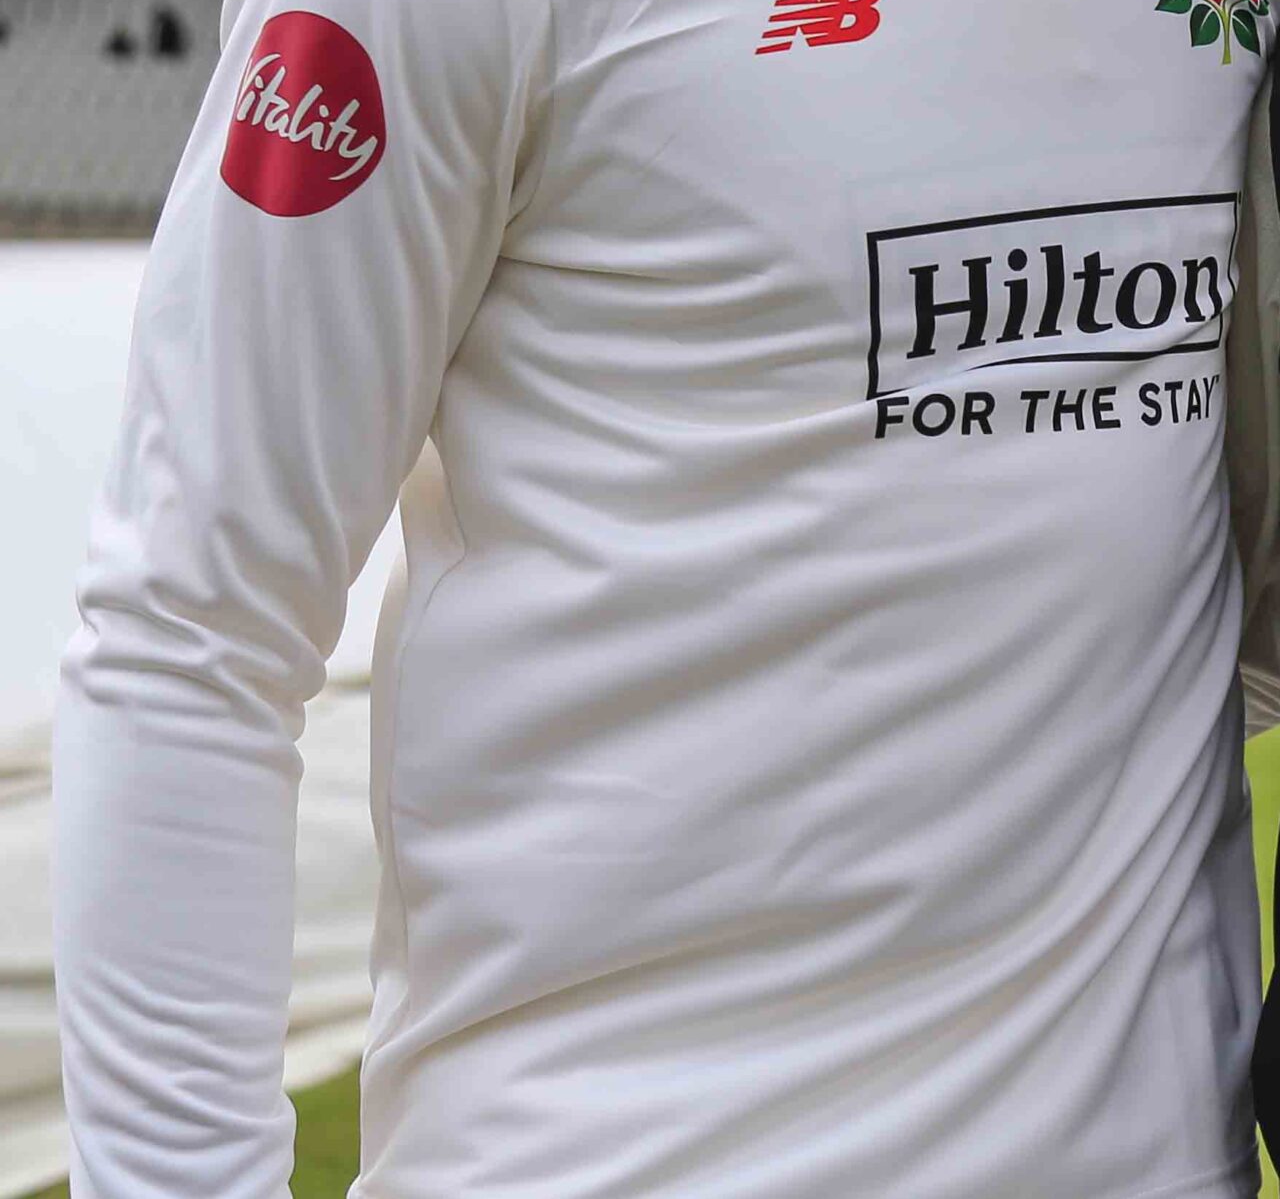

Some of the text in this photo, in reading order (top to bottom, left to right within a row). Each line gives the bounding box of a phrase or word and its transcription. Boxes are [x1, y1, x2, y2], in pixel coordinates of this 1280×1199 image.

[235, 52, 379, 181] Vitality
[905, 244, 1224, 360] Hilton
[874, 391, 996, 440] FOR
[1019, 385, 1122, 434] THE
